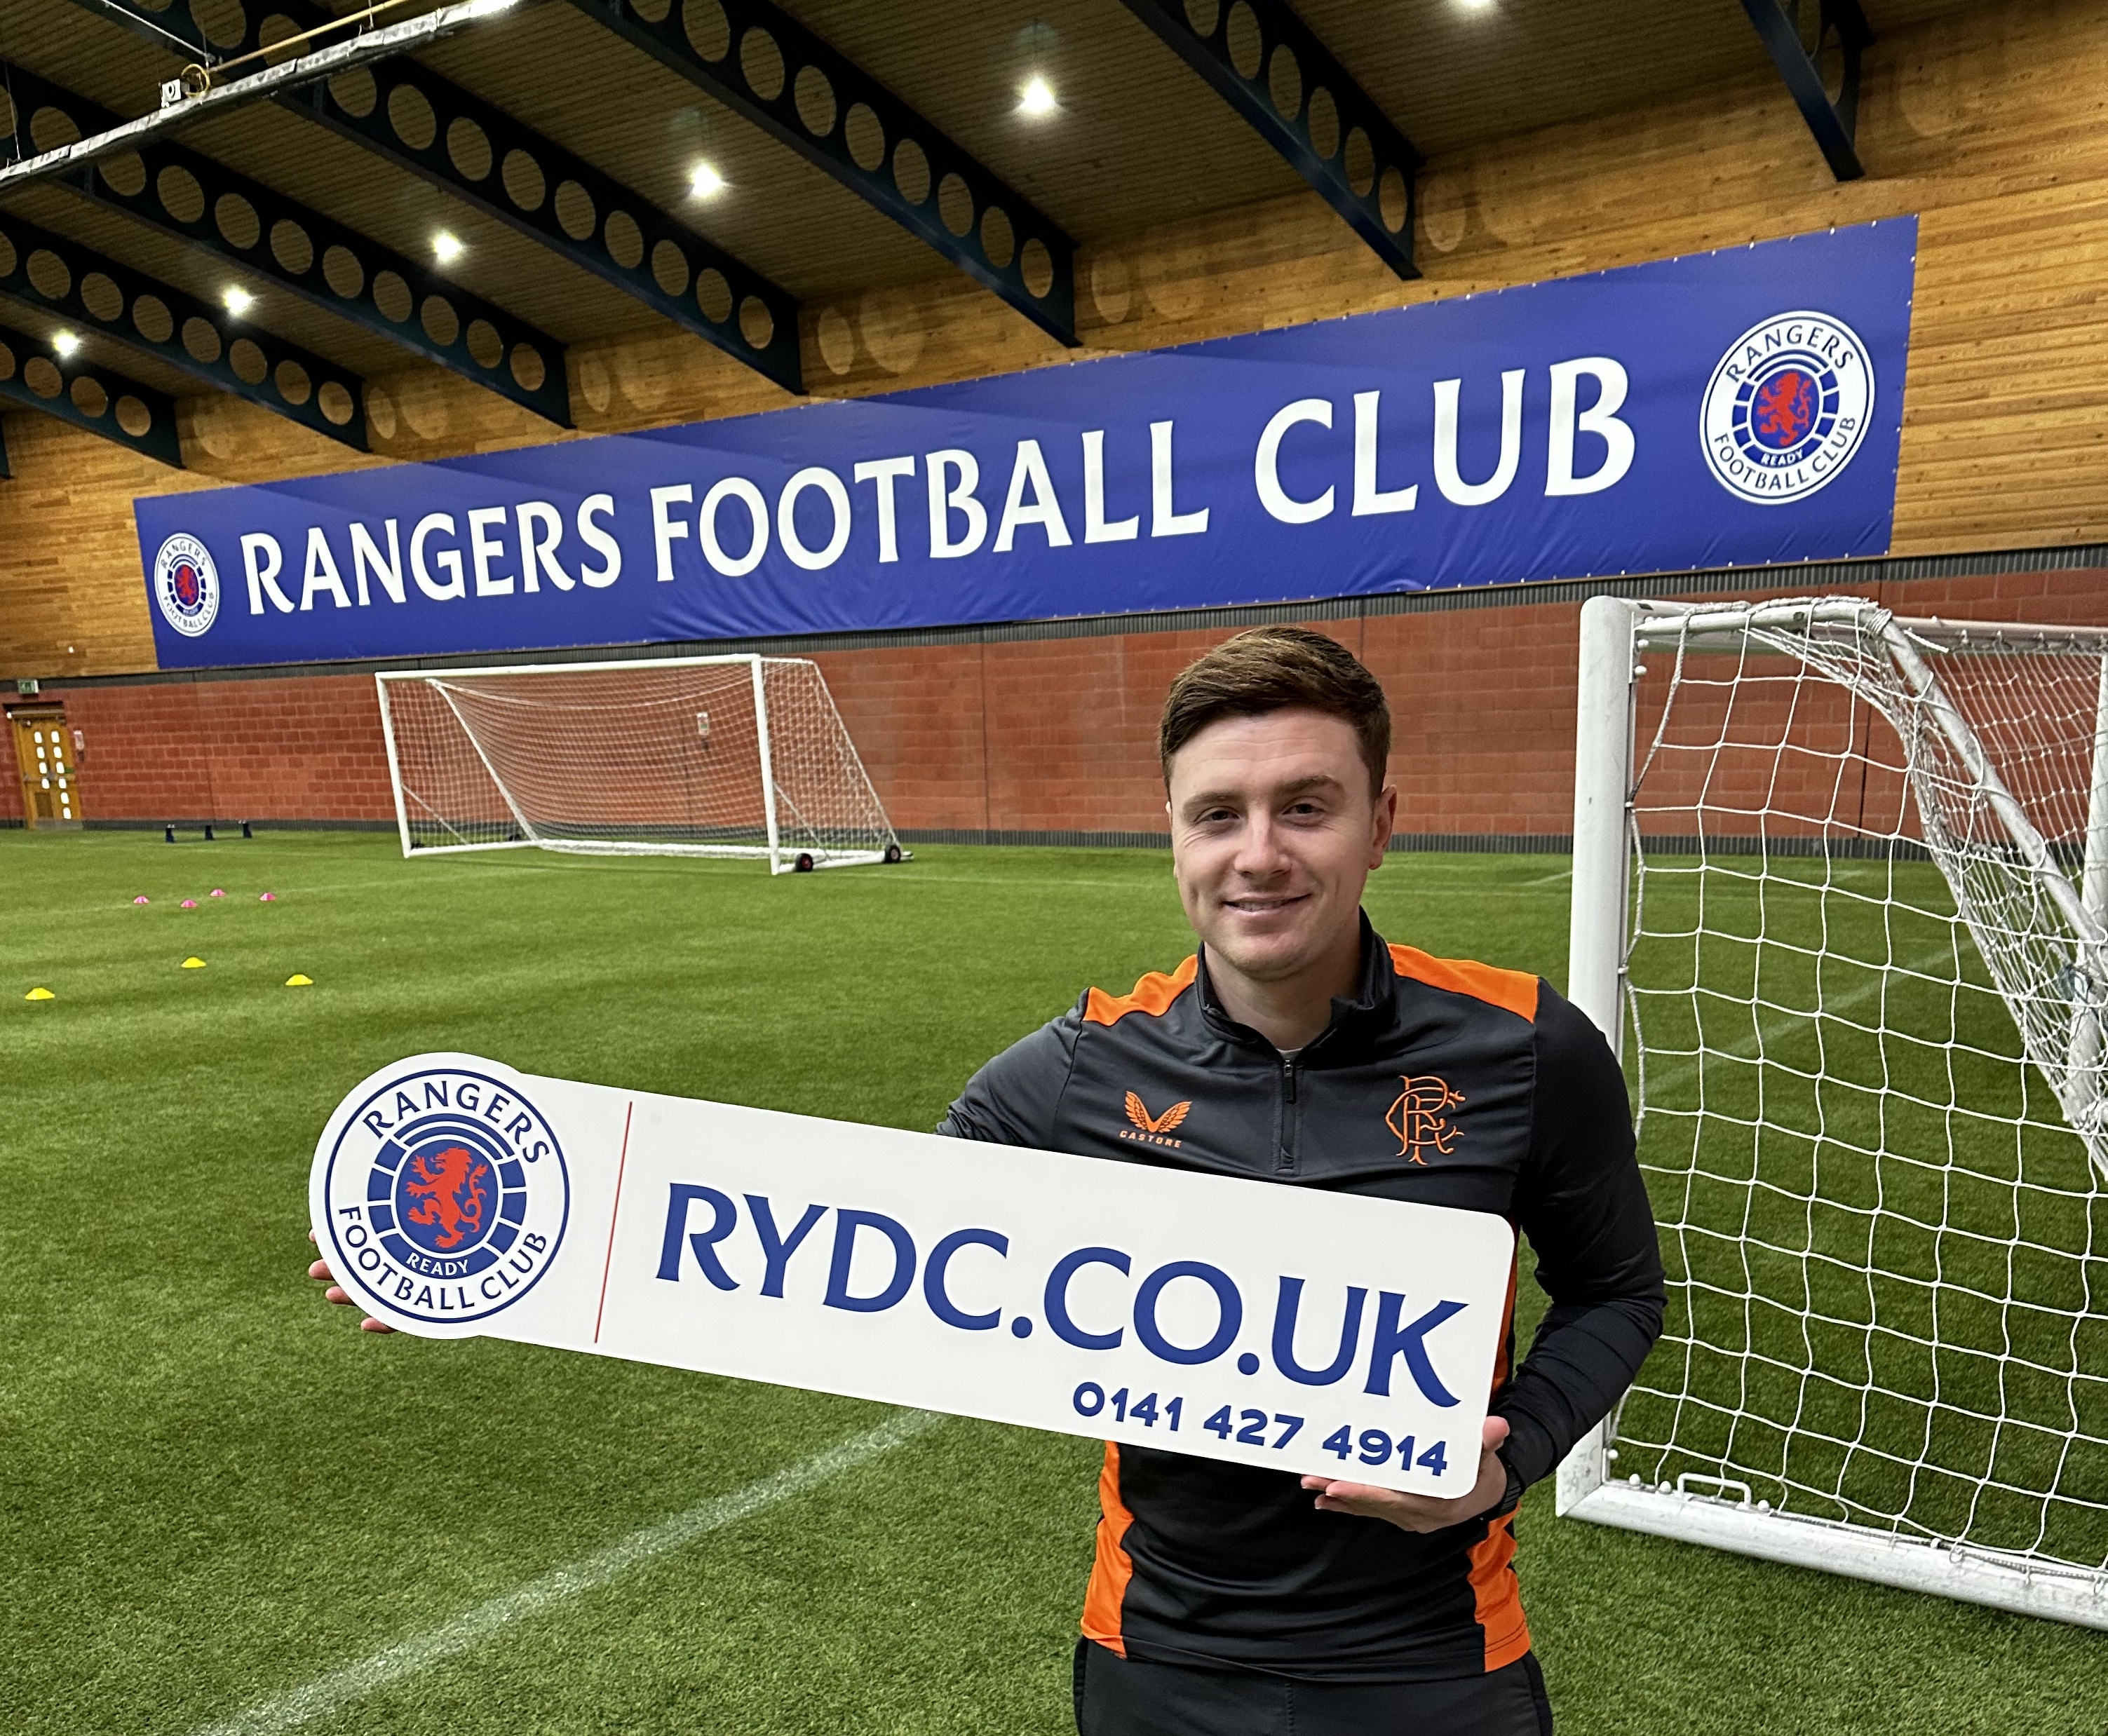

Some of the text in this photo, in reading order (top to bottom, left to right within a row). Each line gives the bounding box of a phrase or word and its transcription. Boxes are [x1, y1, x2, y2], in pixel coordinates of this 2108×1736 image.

[1725, 324, 1854, 383] RANGERS
[239, 355, 1637, 615] RANGERS FOOTBALL CLUB
[1714, 416, 1856, 491] FOOTBALL CLUB
[1759, 447, 1804, 466] READY
[160, 540, 208, 569] RANGERS
[362, 1080, 550, 1165] RANGERS
[1119, 1129, 1183, 1149] CASTORE
[339, 1206, 548, 1310] FOOTBALL CLUB
[405, 1251, 469, 1277] READY
[655, 1181, 1471, 1409] RYDC.CO.UK
[1072, 1381, 1450, 1478] 0141 427 4914
